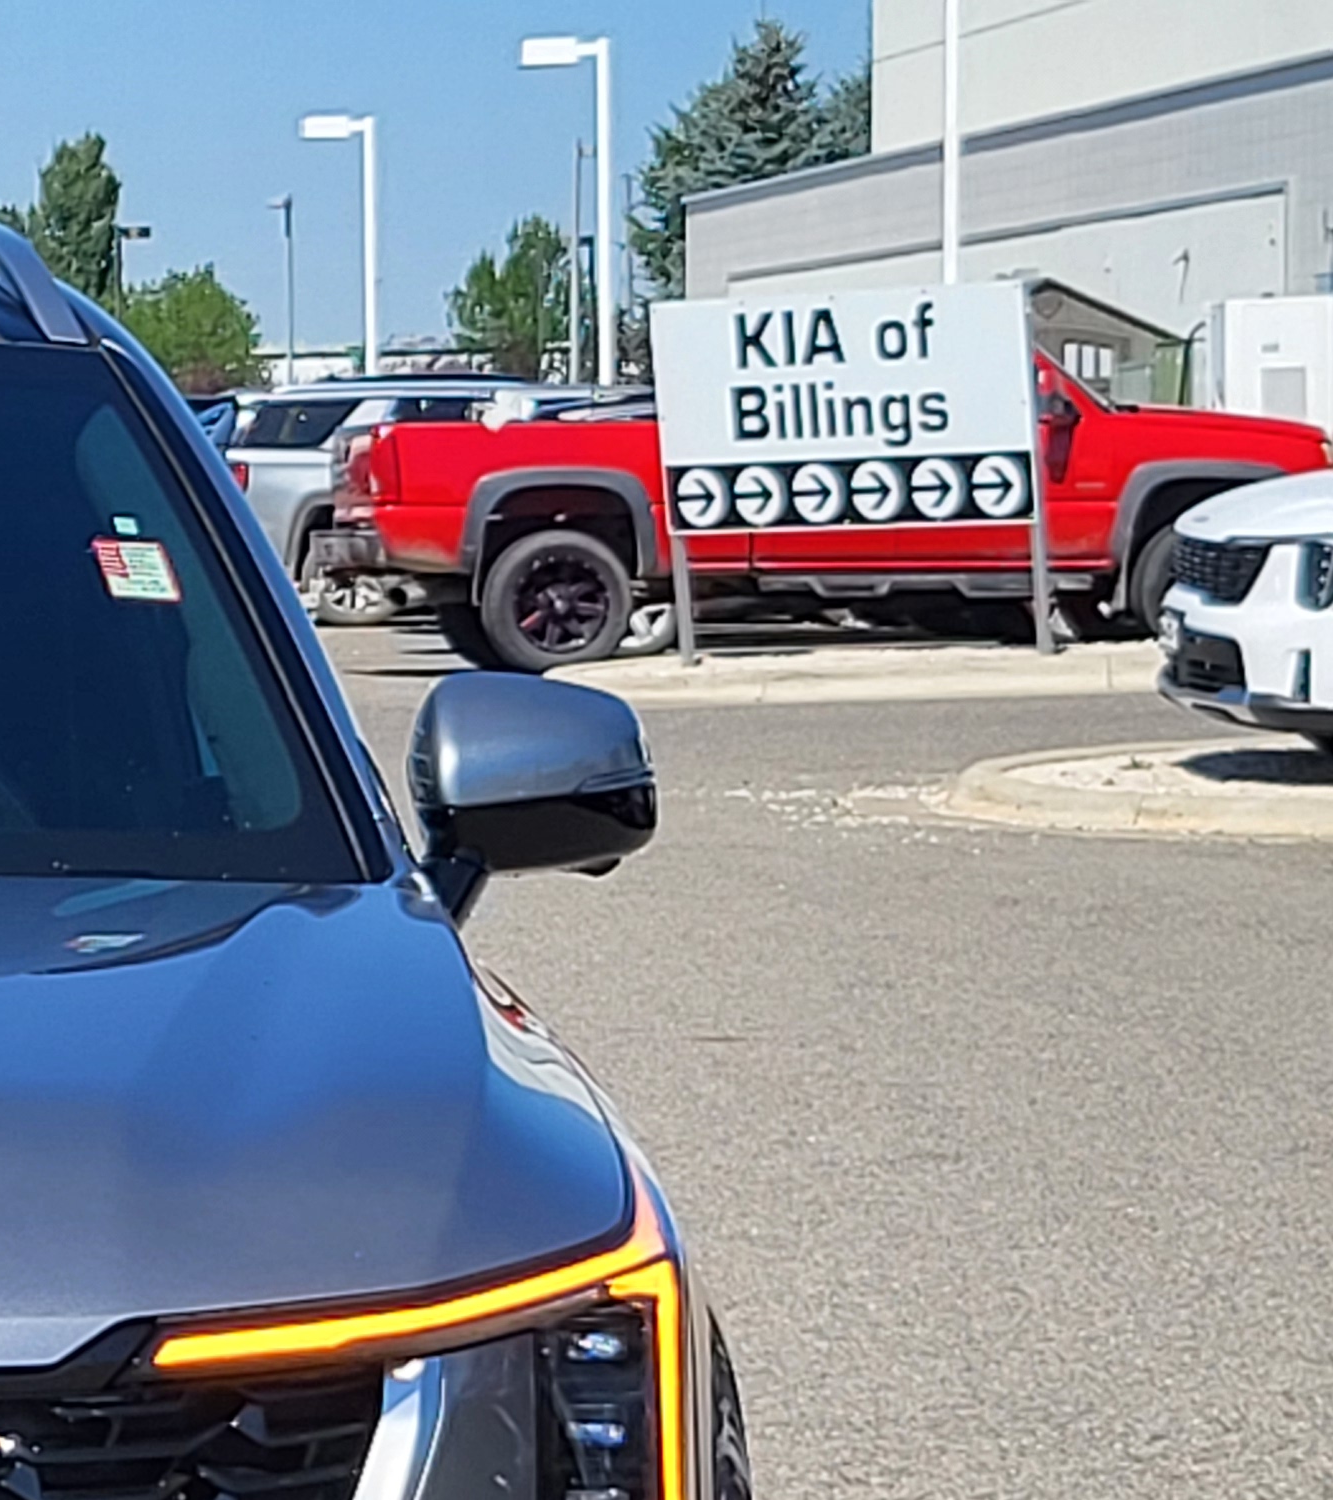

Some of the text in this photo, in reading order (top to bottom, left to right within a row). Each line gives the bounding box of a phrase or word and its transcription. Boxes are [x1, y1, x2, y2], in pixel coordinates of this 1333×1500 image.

[734, 301, 934, 369] KIA of
[730, 381, 949, 447] Billings
